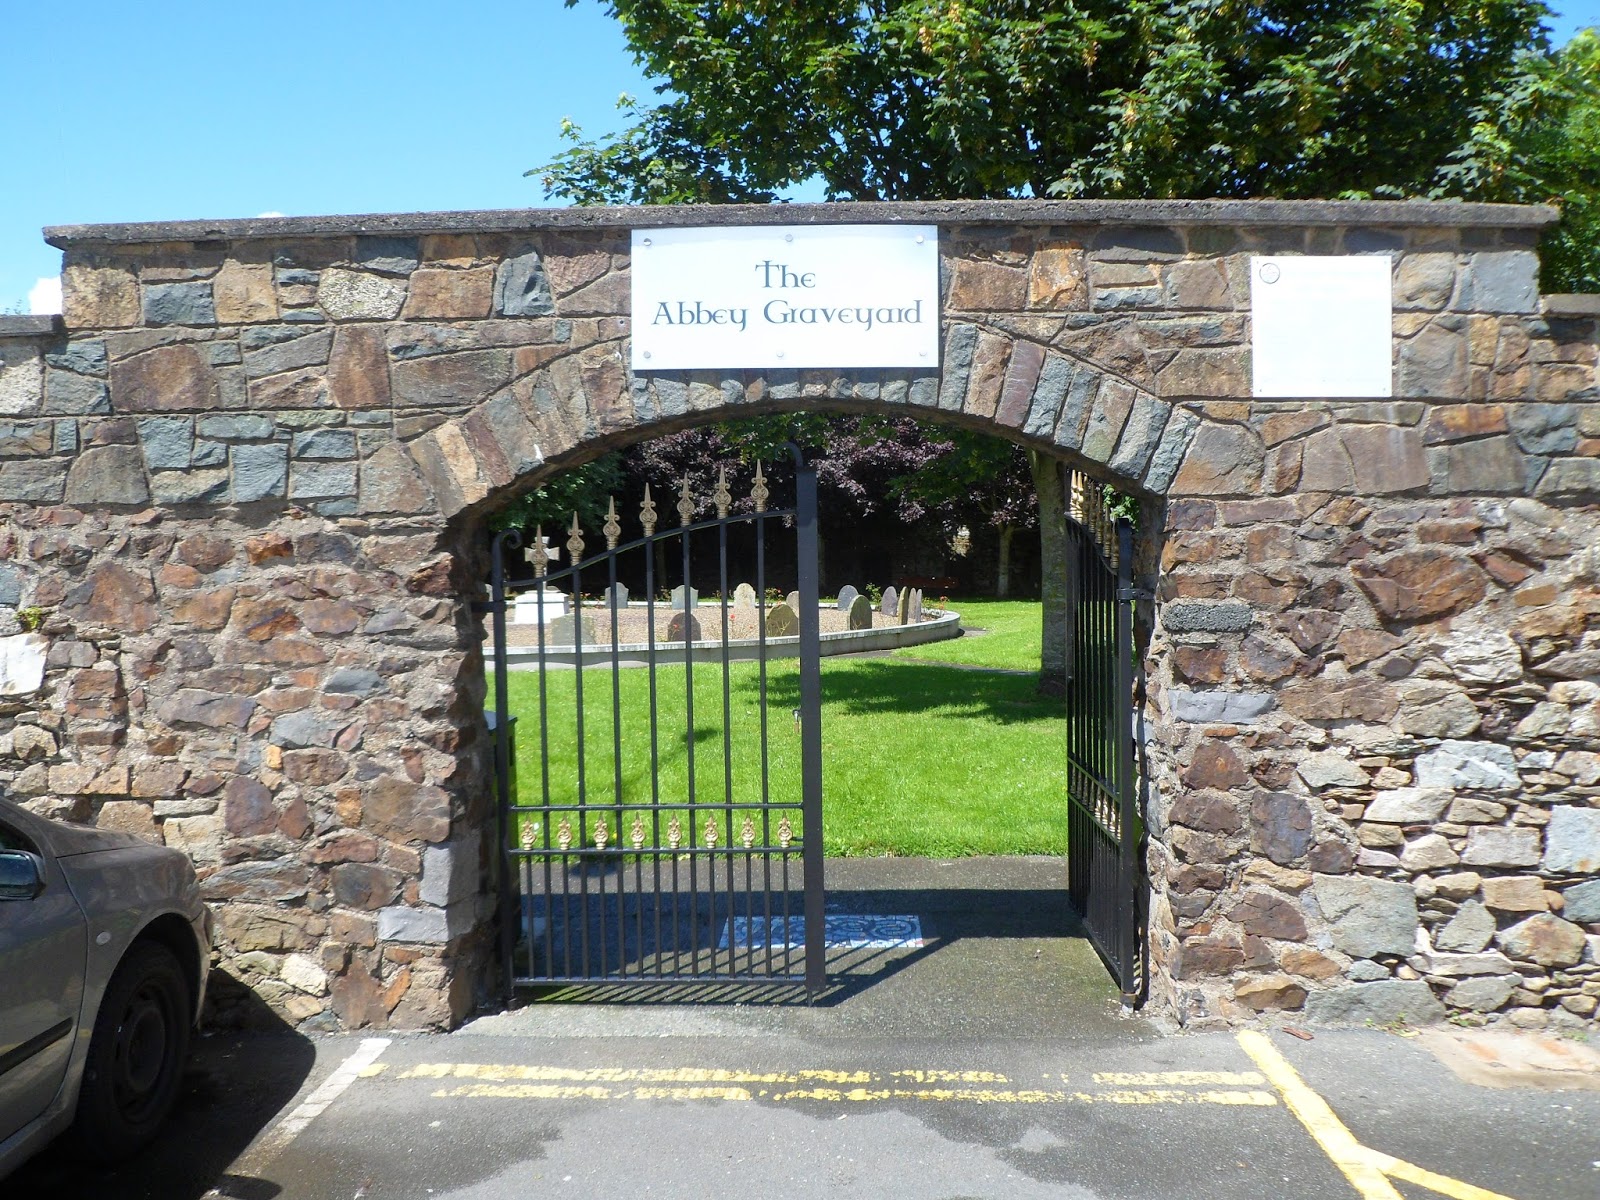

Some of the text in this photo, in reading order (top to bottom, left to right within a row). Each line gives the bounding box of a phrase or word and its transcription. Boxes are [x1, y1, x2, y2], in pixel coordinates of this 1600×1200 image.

[755, 260, 816, 289] The
[651, 299, 923, 332] Abbey Graveyard
